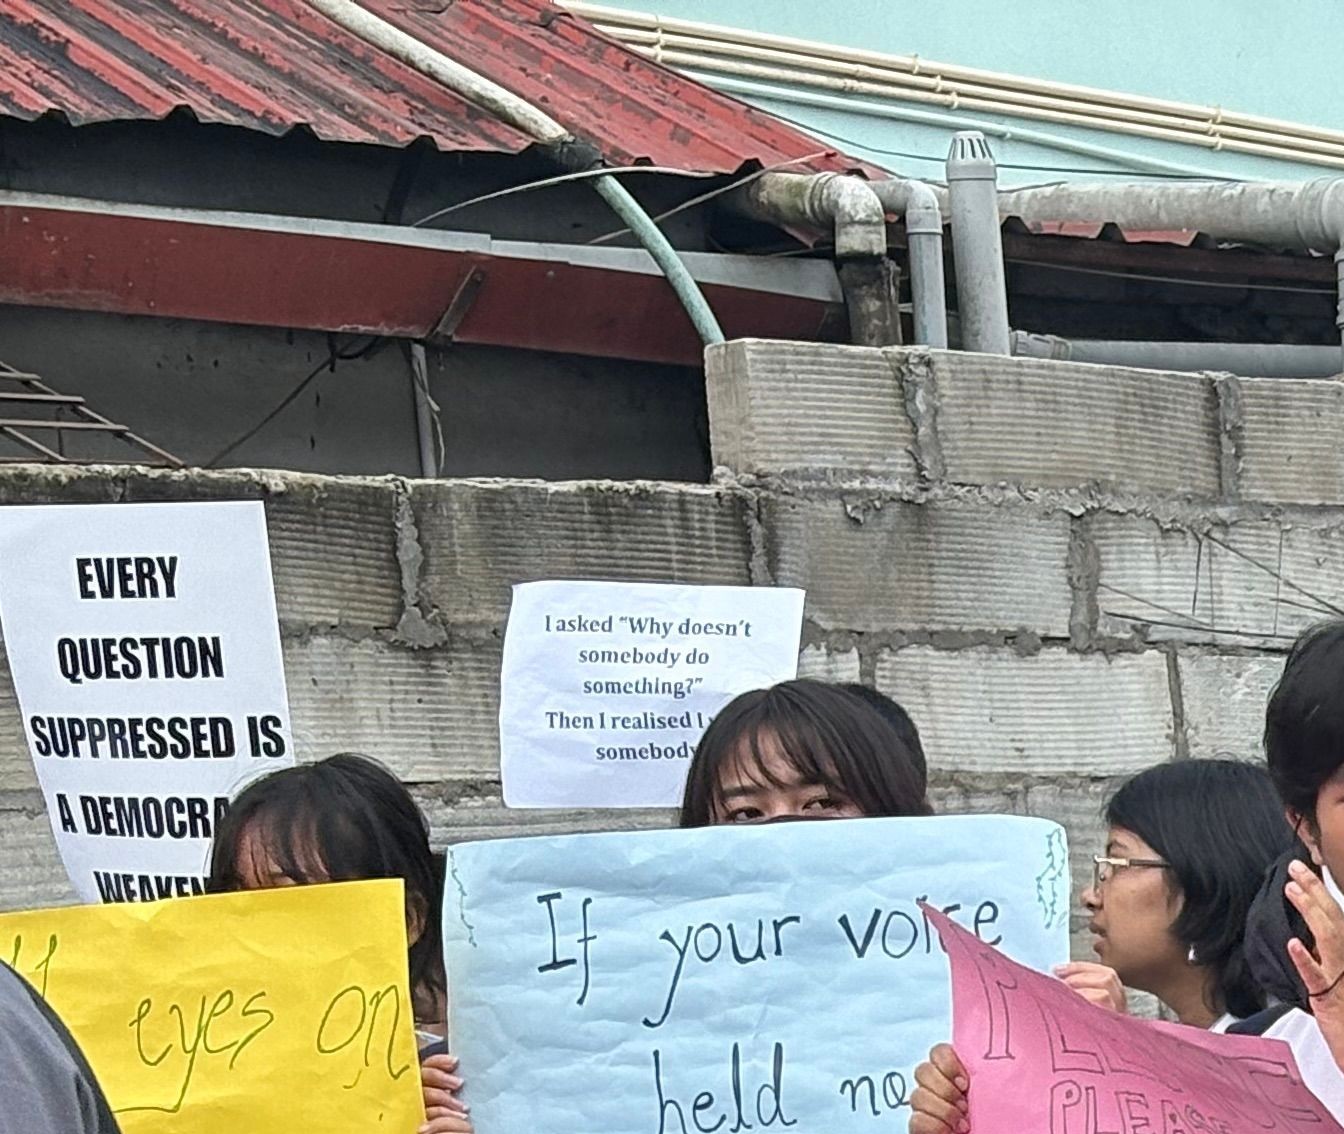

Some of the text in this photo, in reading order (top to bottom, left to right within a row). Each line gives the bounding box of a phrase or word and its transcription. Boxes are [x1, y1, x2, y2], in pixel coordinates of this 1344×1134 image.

[76, 556, 178, 600] EVERY
[545, 615, 552, 632] I
[556, 615, 613, 633] asked
[678, 617, 752, 637] doesn't
[57, 636, 224, 684] QUESTION
[578, 647, 710, 668] somebody do
[30, 715, 286, 760] SUPPRESSED IS
[545, 712, 594, 729] Then
[600, 712, 606, 729] I
[611, 711, 692, 730] realised
[697, 712, 704, 729] I
[56, 793, 78, 833] A
[537, 893, 597, 1005] If
[643, 915, 801, 1028] your
[113, 985, 410, 1113] eyes on
[840, 1071, 910, 1117] no
